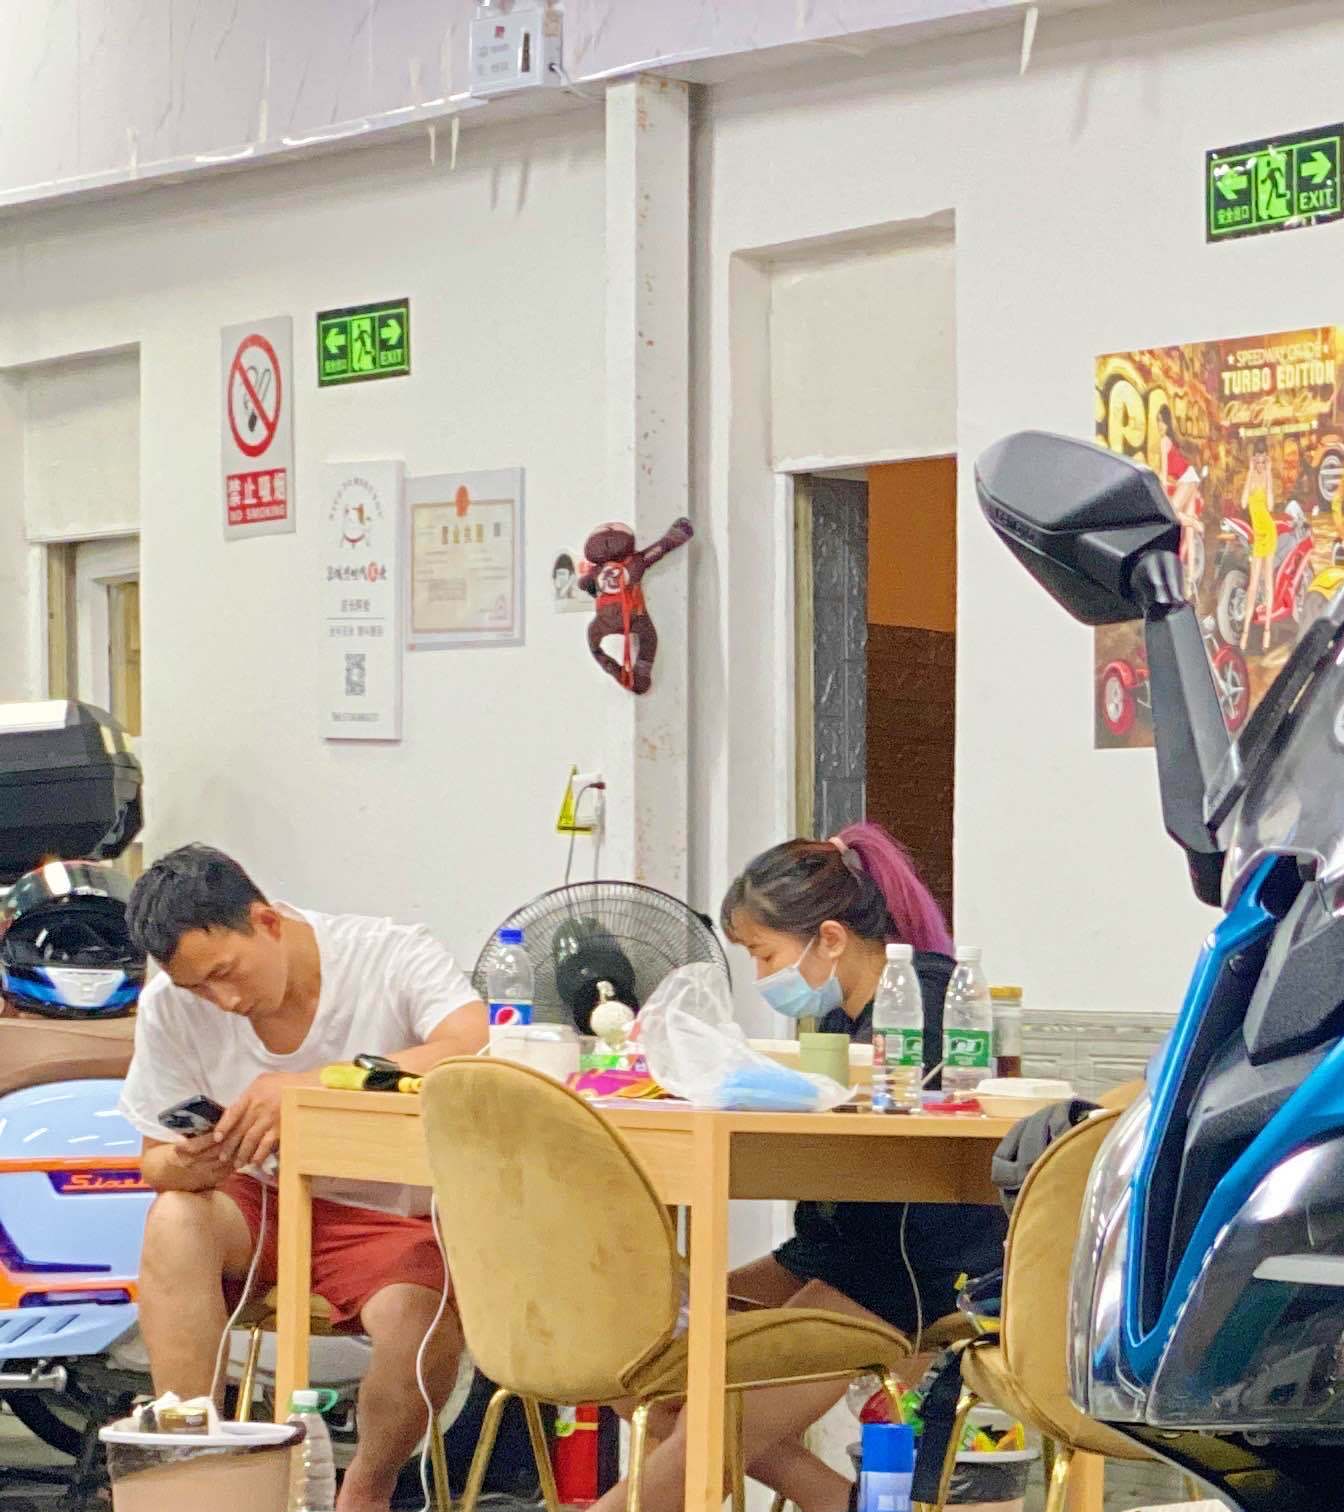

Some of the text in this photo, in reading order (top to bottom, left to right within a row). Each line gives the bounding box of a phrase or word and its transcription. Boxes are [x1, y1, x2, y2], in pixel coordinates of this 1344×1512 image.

[1301, 188, 1334, 210] EXIT
[1221, 360, 1335, 395] TURBO EDITION
